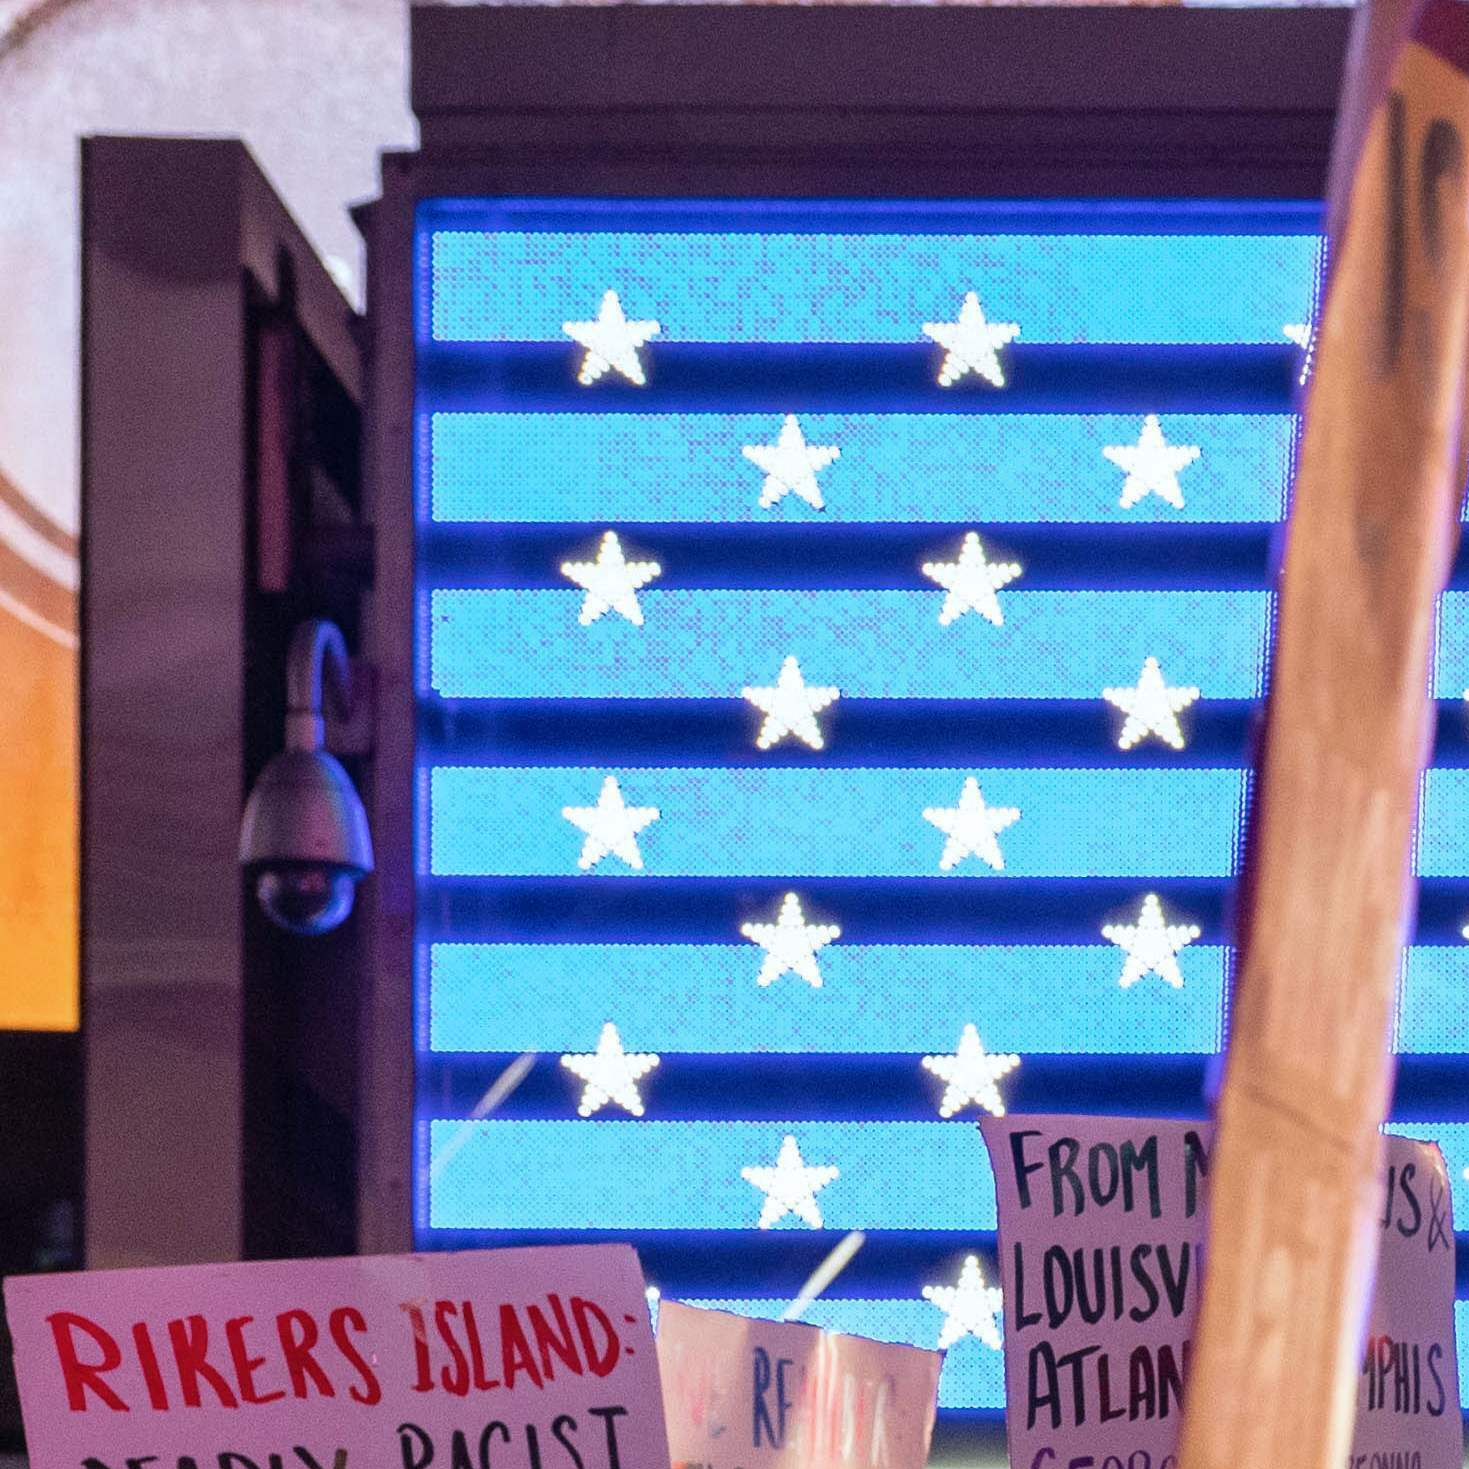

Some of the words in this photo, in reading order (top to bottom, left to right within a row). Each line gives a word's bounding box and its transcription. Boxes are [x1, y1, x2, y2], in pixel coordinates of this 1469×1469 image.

[1009, 1131, 1162, 1219] FROM
[1014, 1241, 1200, 1332] LOUISV
[45, 1307, 381, 1413] RIKERS
[399, 1293, 636, 1397] ISLAND:
[1027, 1340, 1190, 1432] ATLAN
